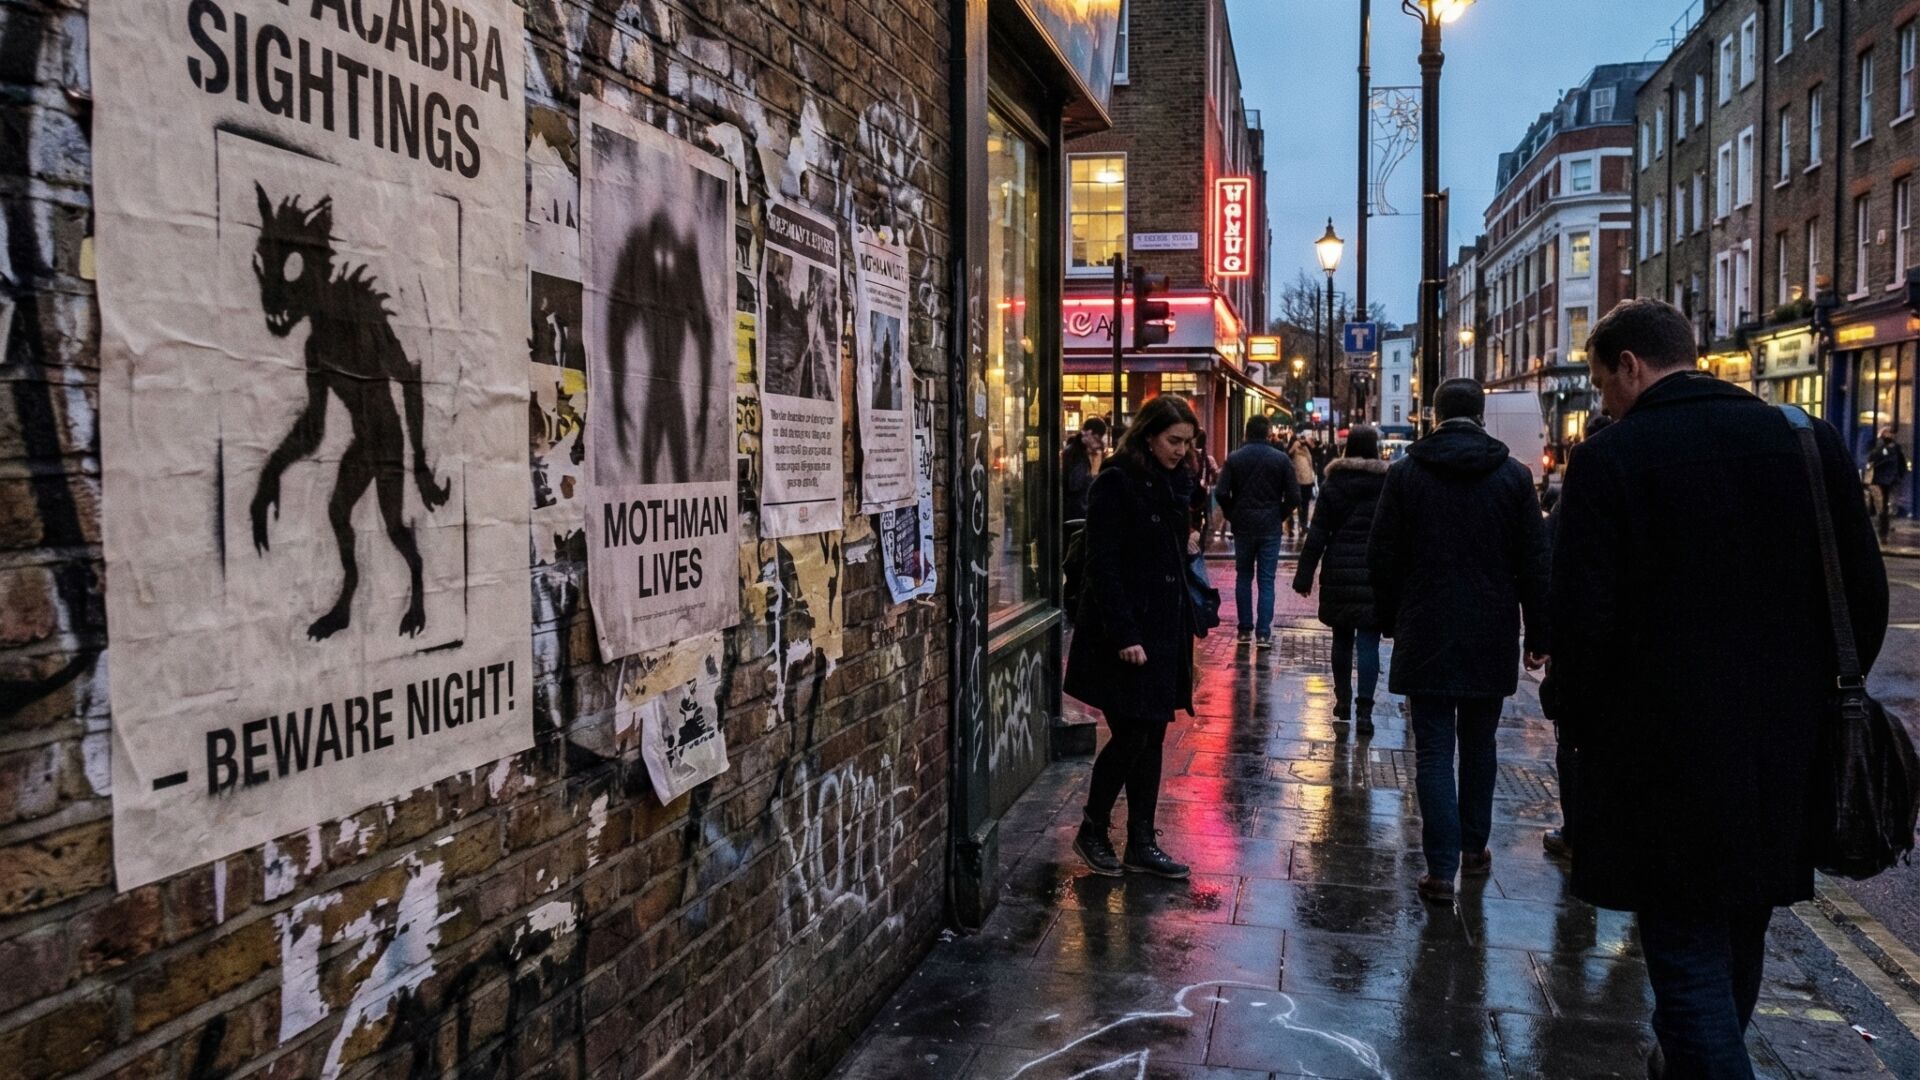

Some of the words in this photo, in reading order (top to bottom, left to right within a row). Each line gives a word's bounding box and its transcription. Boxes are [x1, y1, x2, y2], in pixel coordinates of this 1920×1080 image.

[187, 0, 481, 179] SIGHTINGS
[309, 0, 509, 101] CABRA
[604, 495, 728, 548] MOTHMAN
[638, 547, 703, 598] LIVES
[206, 688, 394, 796] BEWARE
[406, 660, 515, 740] NIGHT!
